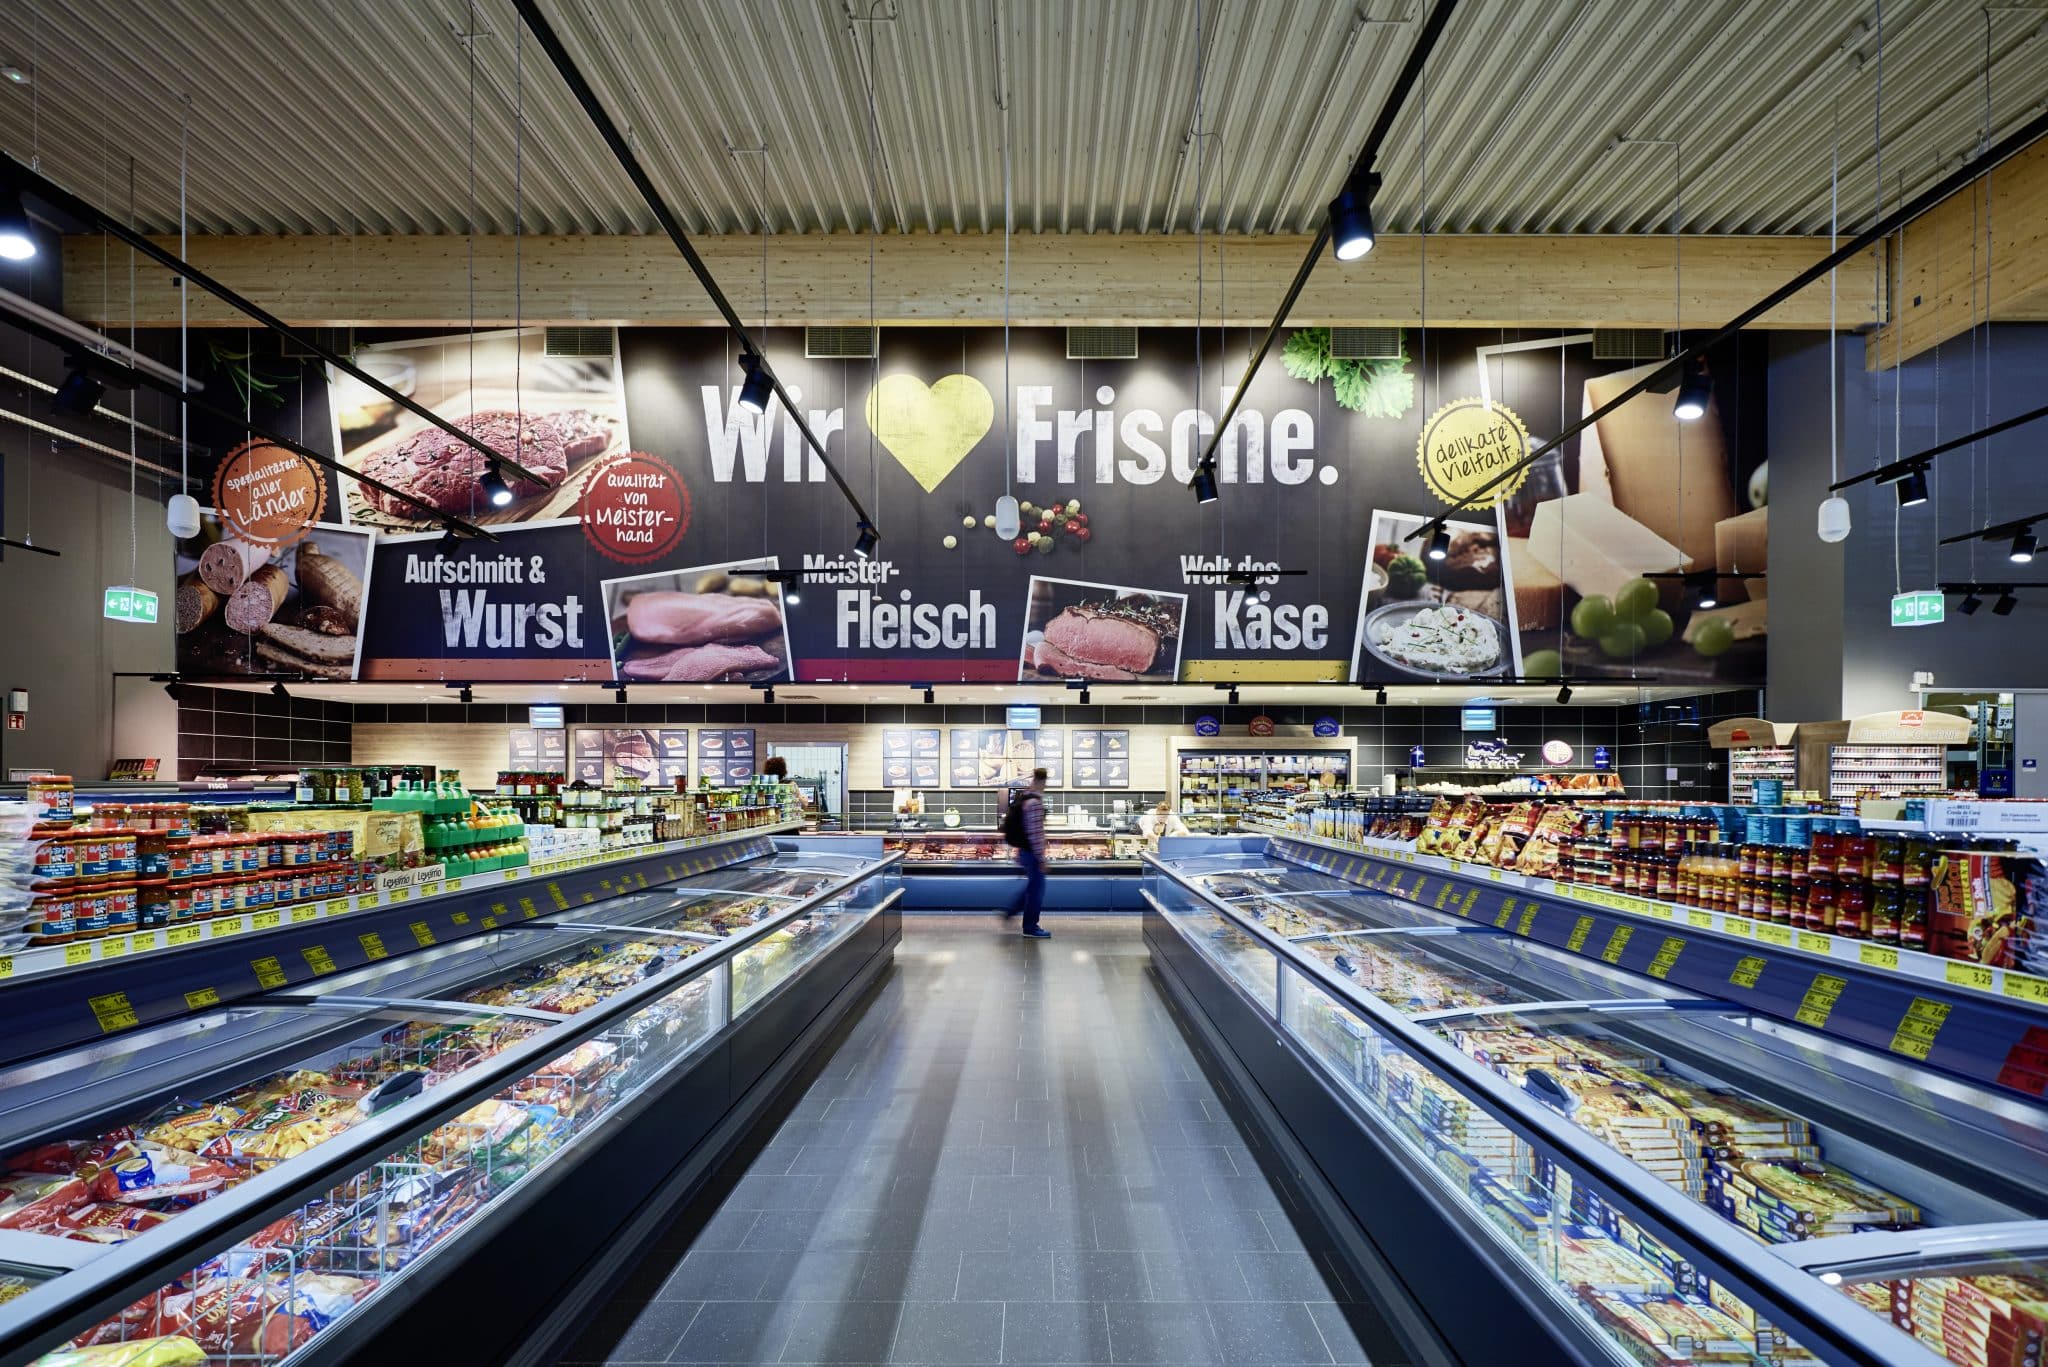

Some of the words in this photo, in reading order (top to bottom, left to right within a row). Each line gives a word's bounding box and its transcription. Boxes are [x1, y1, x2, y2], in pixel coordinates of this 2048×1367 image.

[701, 385, 844, 483] Wir
[1016, 385, 1339, 486] Frische.
[1436, 425, 1507, 463] delikate
[227, 458, 297, 492] Spezialitäten
[253, 479, 281, 499] aller
[607, 474, 666, 488] Qualität
[236, 486, 306, 526] Länder
[624, 492, 648, 505] von
[596, 507, 674, 527] Meister-
[616, 528, 653, 543] hand
[404, 553, 524, 584] Aufschnitt
[528, 555, 545, 584] &
[803, 554, 900, 584] Meister-
[438, 588, 584, 650] Wurst
[837, 589, 997, 649] Fleisch
[1214, 590, 1329, 650] Käse
